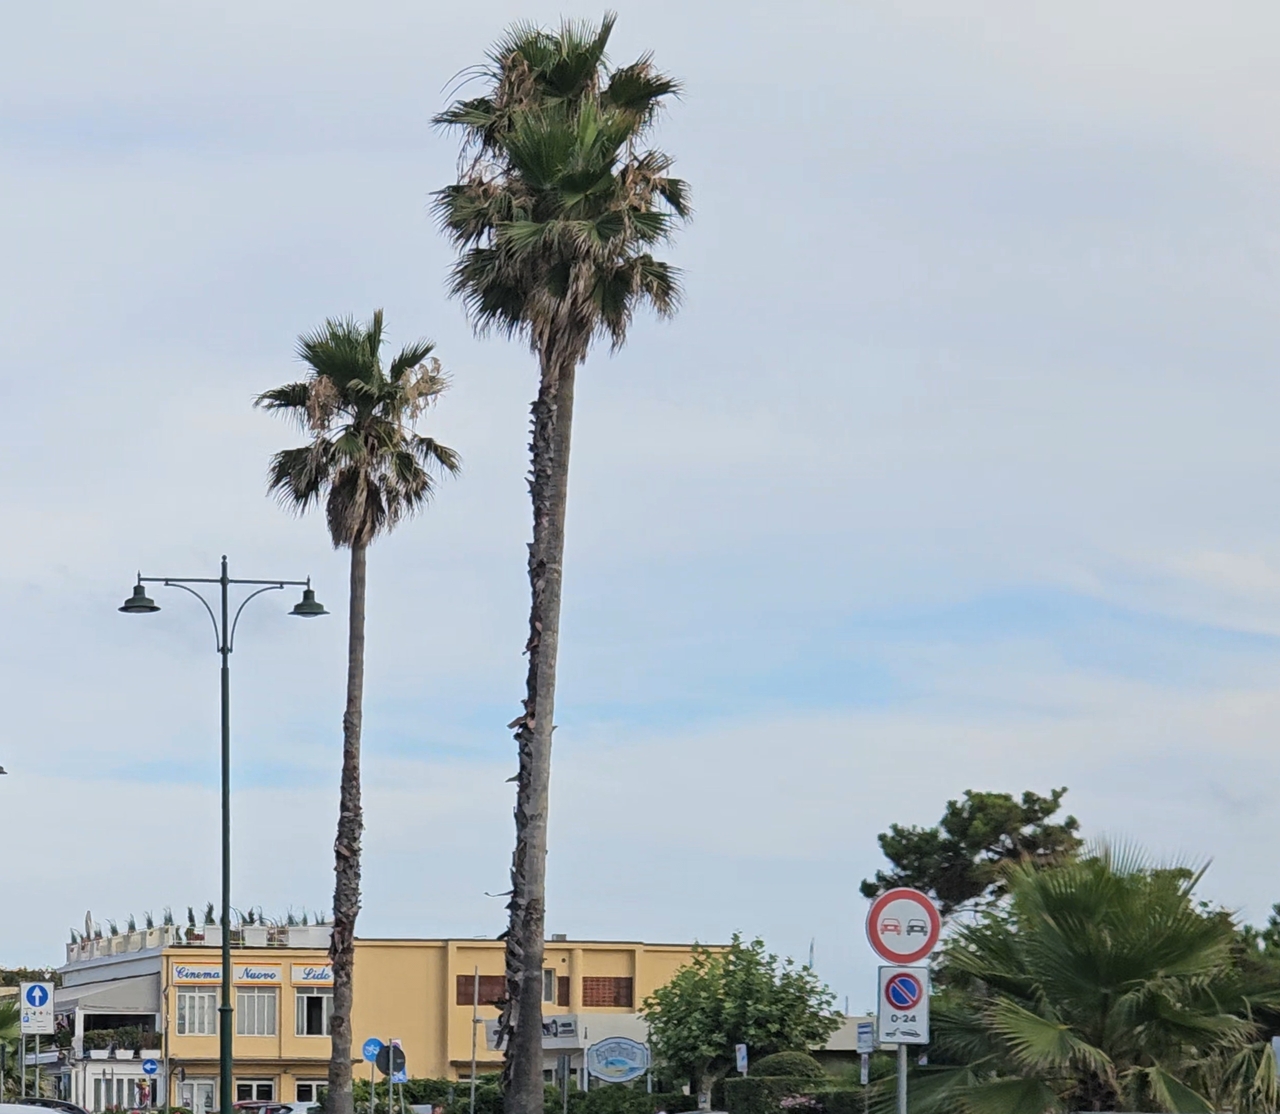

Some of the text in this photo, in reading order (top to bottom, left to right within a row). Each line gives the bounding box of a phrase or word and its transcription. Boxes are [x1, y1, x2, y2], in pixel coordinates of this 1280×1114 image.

[175, 965, 331, 981] Cinema Nuovo Lido
[890, 1013, 917, 1023] 0-24
